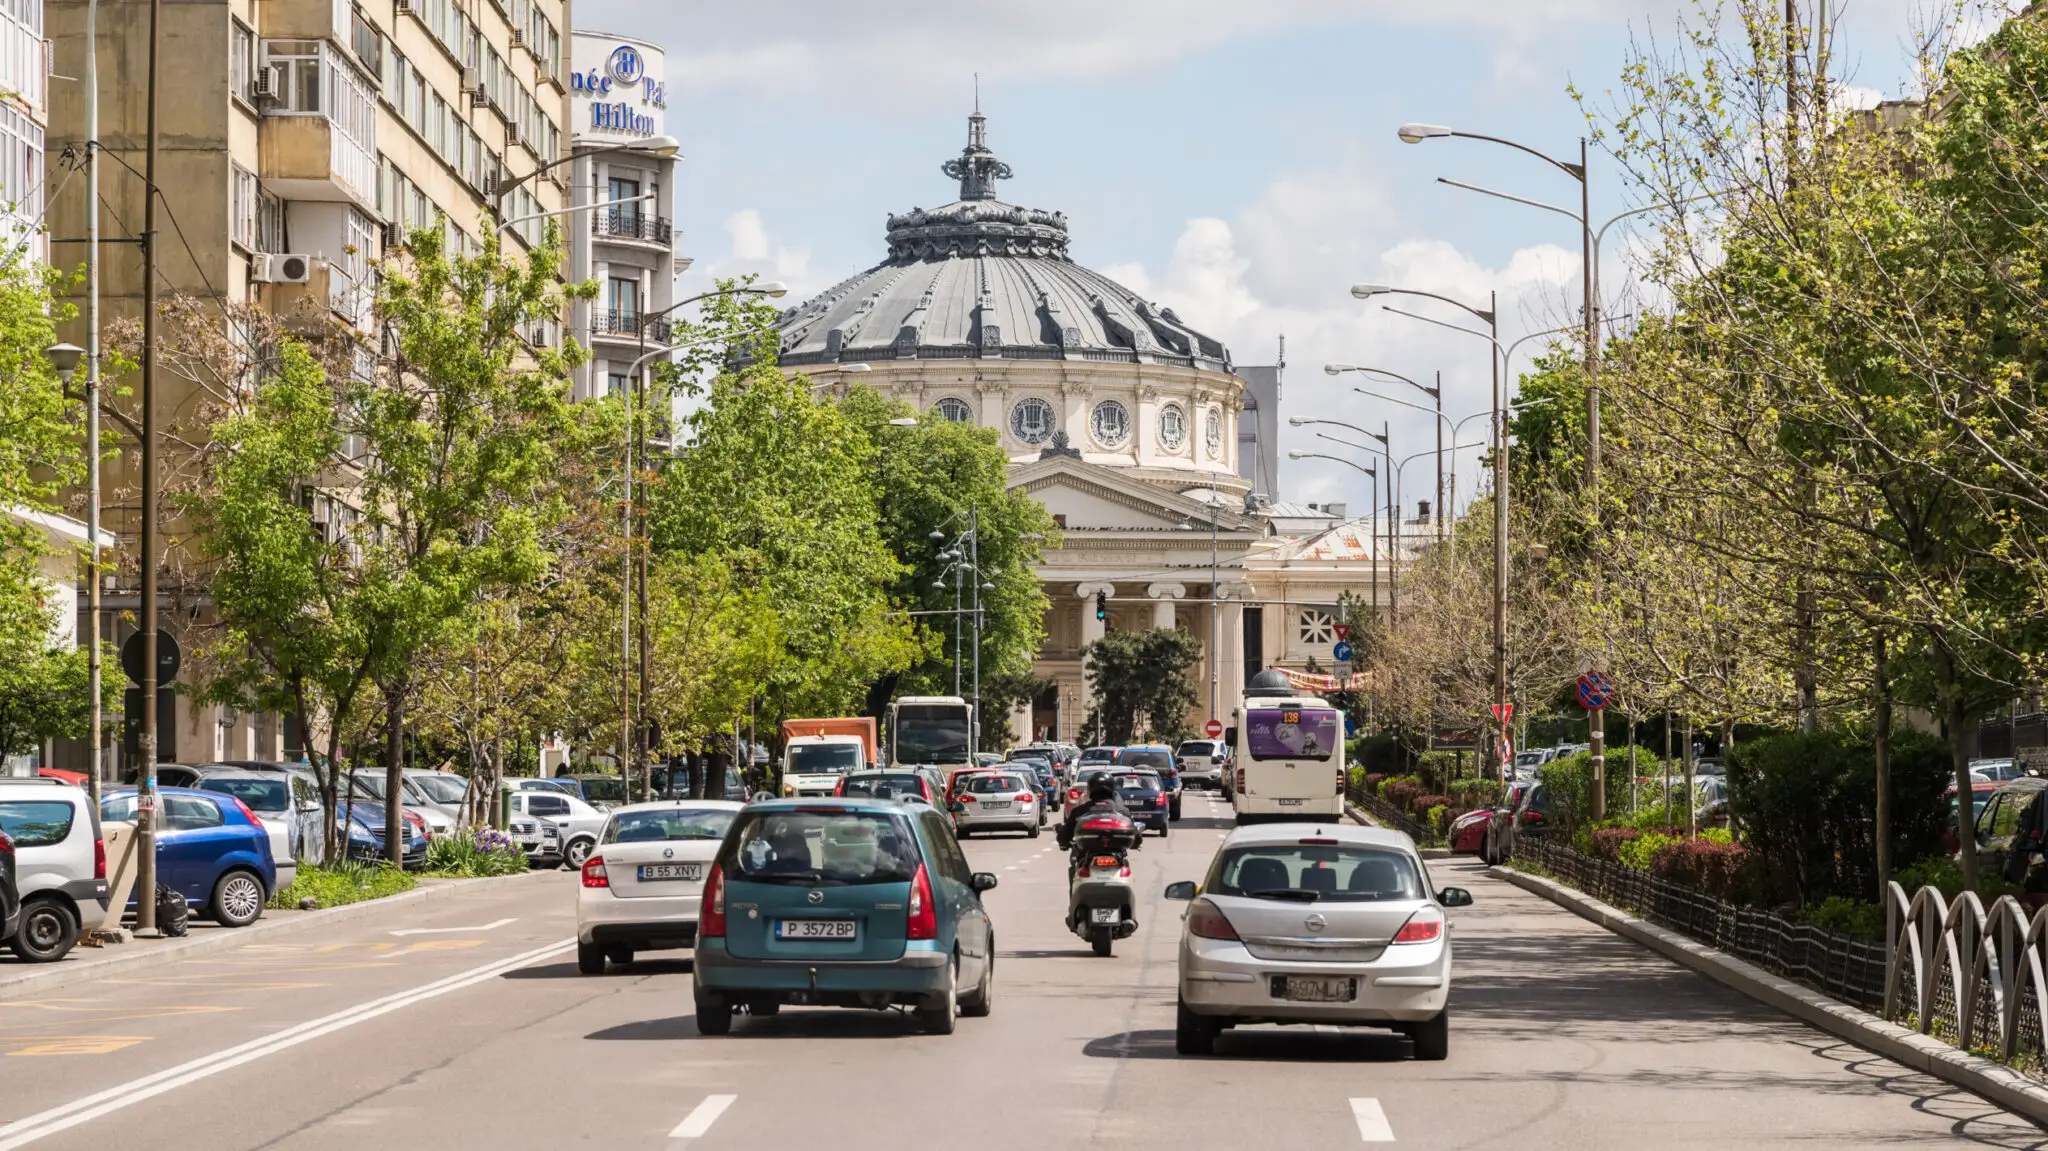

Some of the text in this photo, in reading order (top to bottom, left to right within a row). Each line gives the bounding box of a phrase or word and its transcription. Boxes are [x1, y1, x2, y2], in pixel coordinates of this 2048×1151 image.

[591, 102, 655, 135] Hilton
[1283, 711, 1299, 723] 138
[645, 866, 697, 877] B 55 XNY
[788, 923, 853, 936] P 3572 BP
